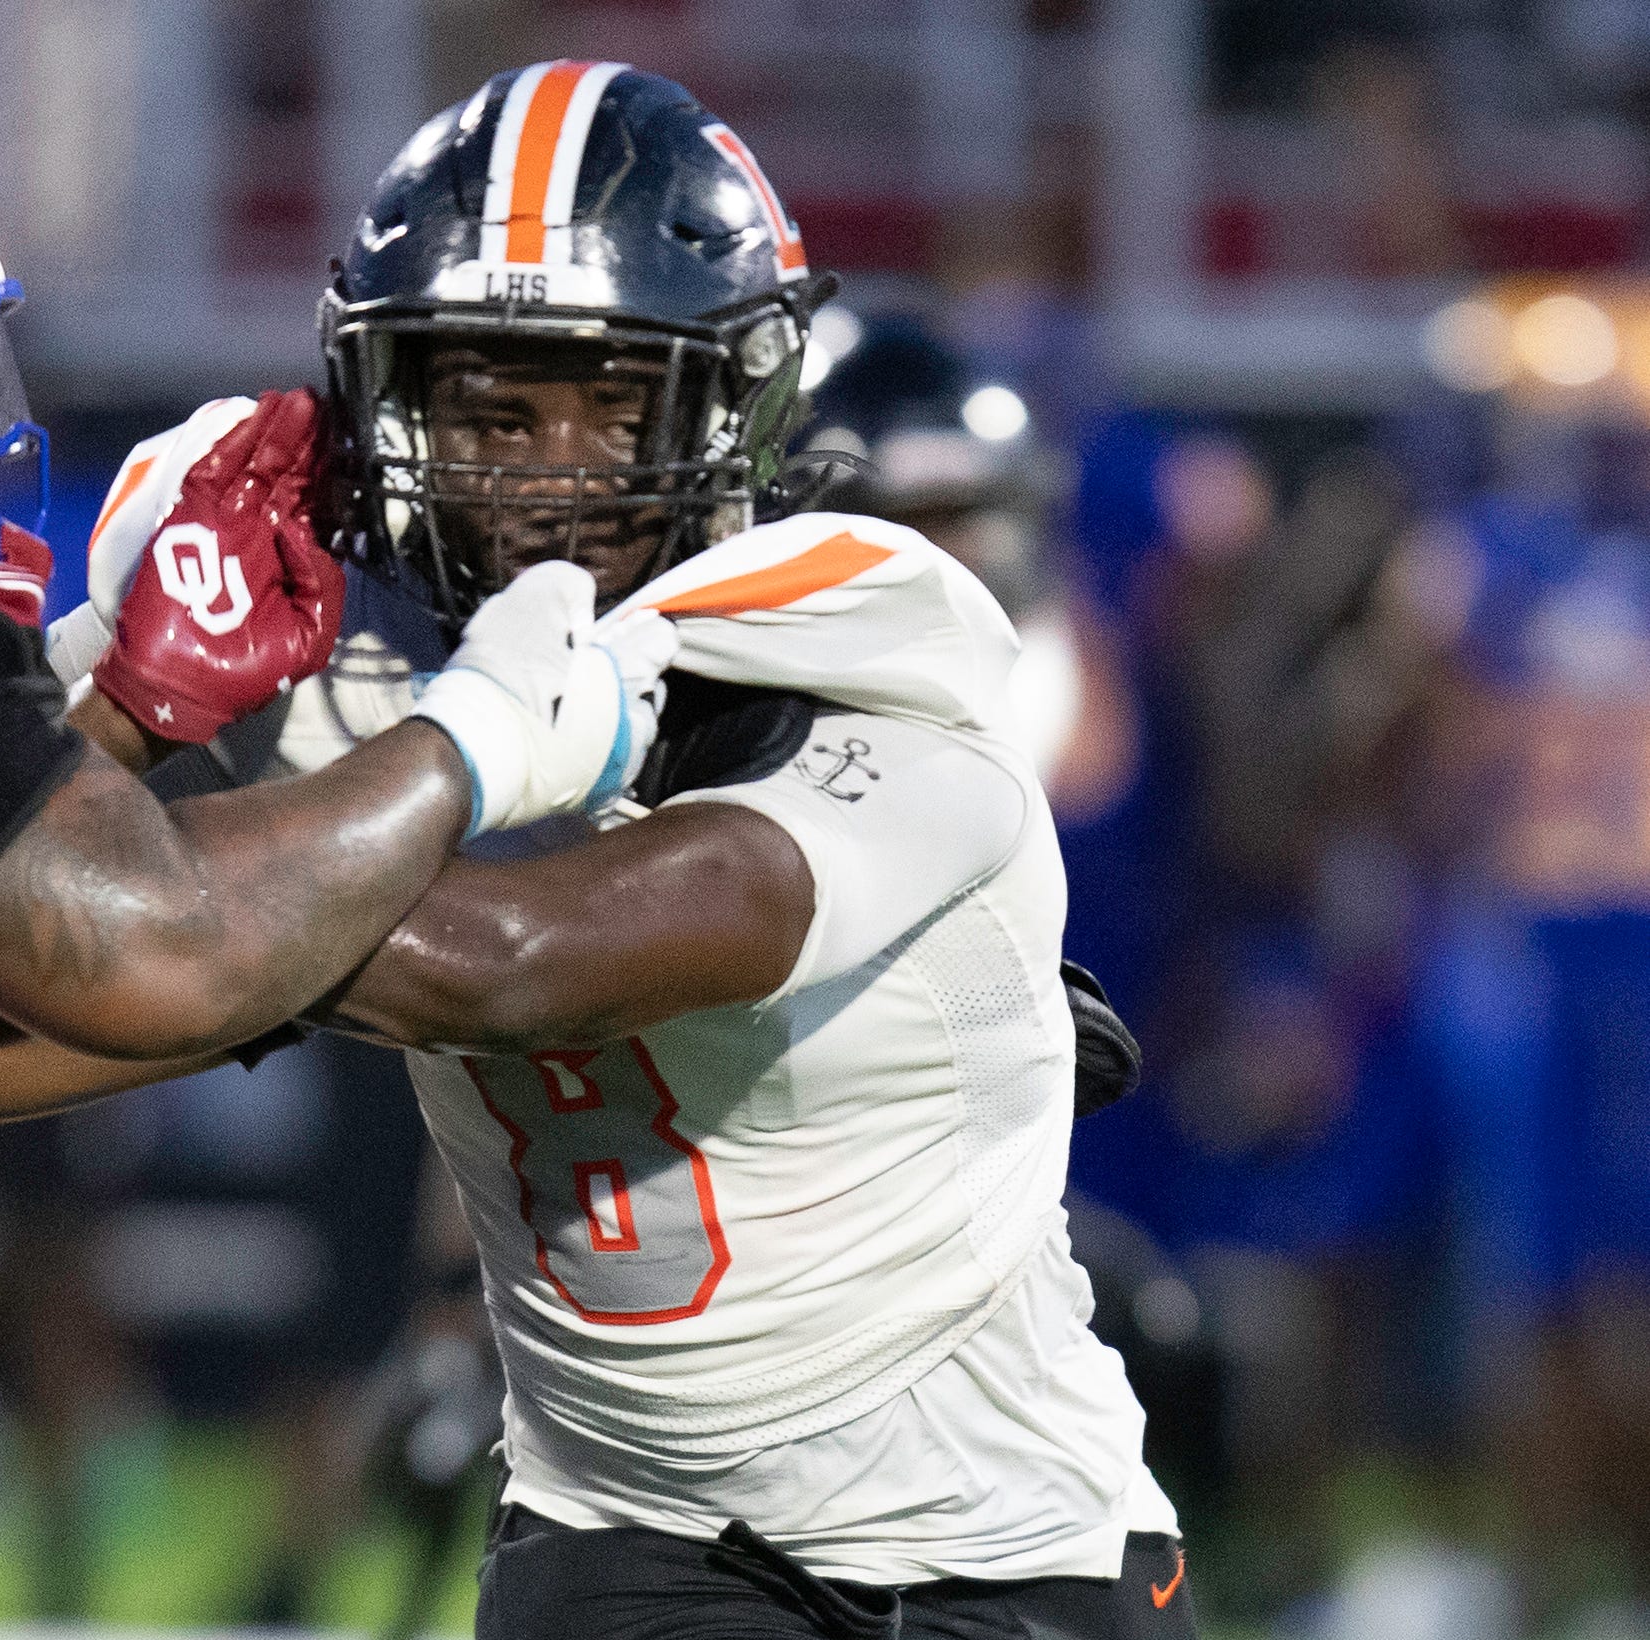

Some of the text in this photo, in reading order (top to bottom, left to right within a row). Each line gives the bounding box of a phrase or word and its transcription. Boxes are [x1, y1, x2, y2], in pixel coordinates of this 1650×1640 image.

[485, 271, 548, 302] LHS
[152, 521, 253, 636] OU
[459, 1034, 733, 1325] 8
